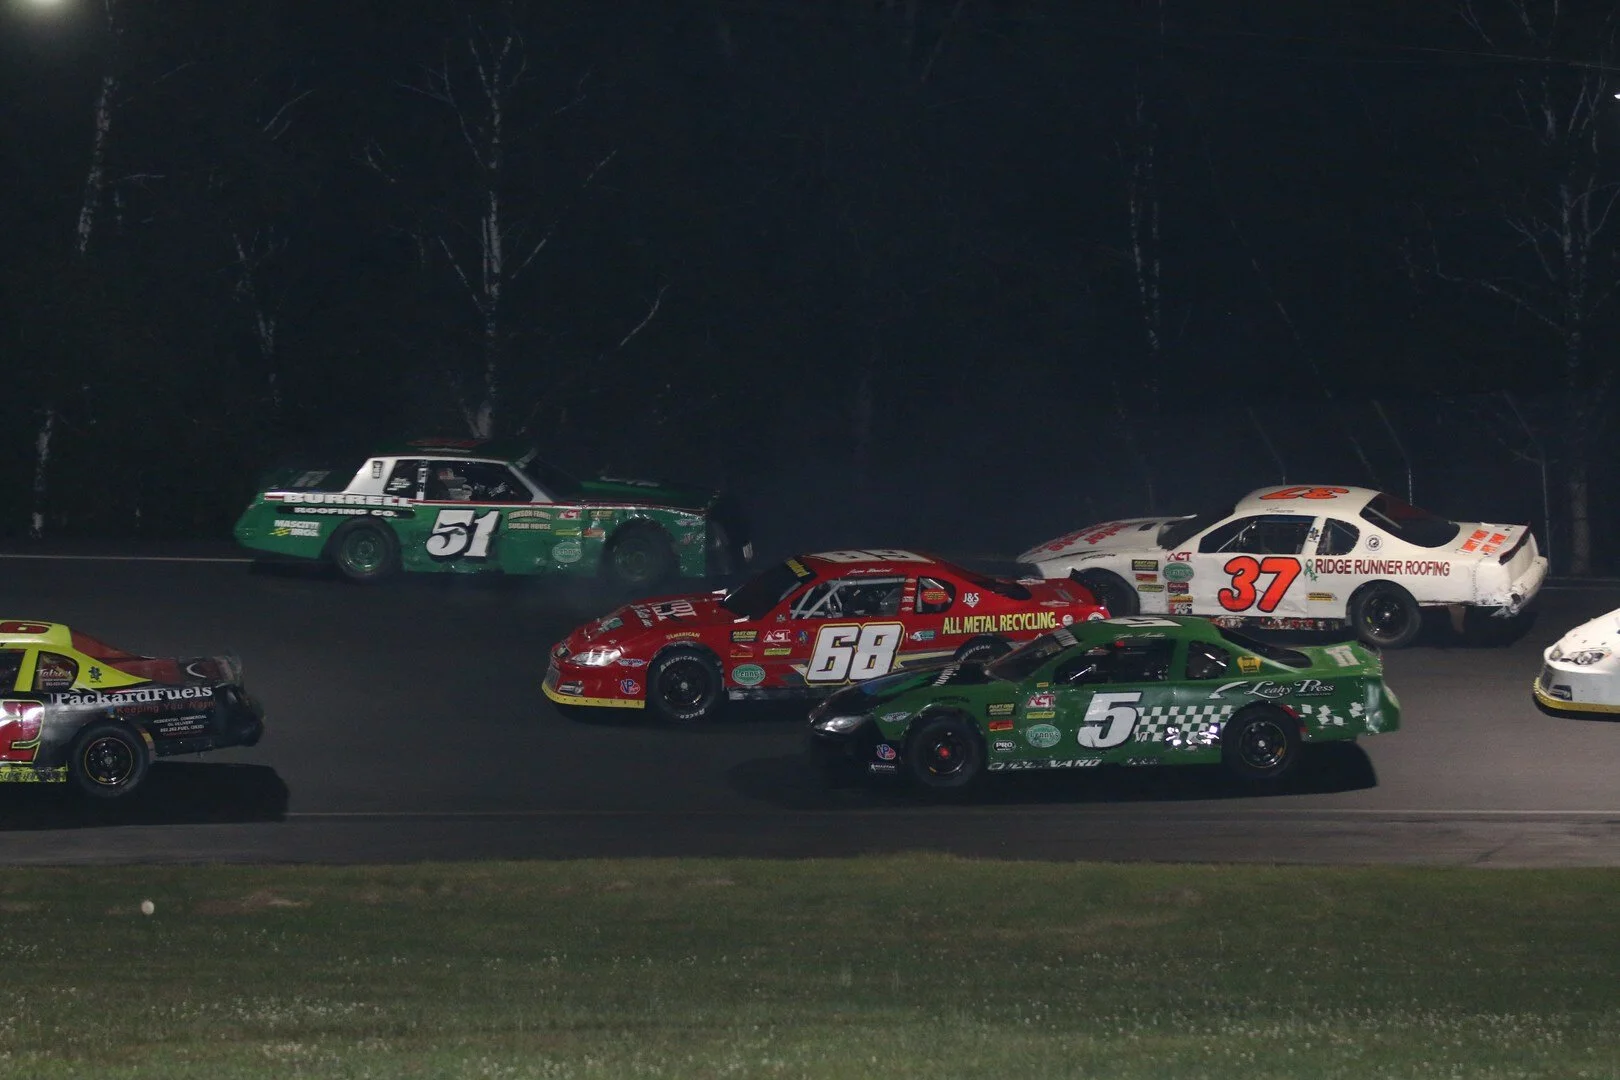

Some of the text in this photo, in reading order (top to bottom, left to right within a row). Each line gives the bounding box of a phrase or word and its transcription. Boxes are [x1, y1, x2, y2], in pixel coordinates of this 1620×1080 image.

[283, 494, 413, 508] BURRELL
[294, 507, 368, 515] ROOFING
[426, 509, 499, 558] 51
[1167, 552, 1192, 562] ACT
[1315, 559, 1450, 577] RIDGE RUNNER ROOFING
[1217, 556, 1302, 613] 37
[963, 592, 980, 603] J&S
[942, 611, 1057, 635] ALL METAL RECYCLING
[804, 622, 904, 686] 68
[1243, 679, 1335, 699] Leahy Press
[116, 704, 160, 715] Keeping
[163, 702, 184, 710] You
[1076, 691, 1142, 750] 5
